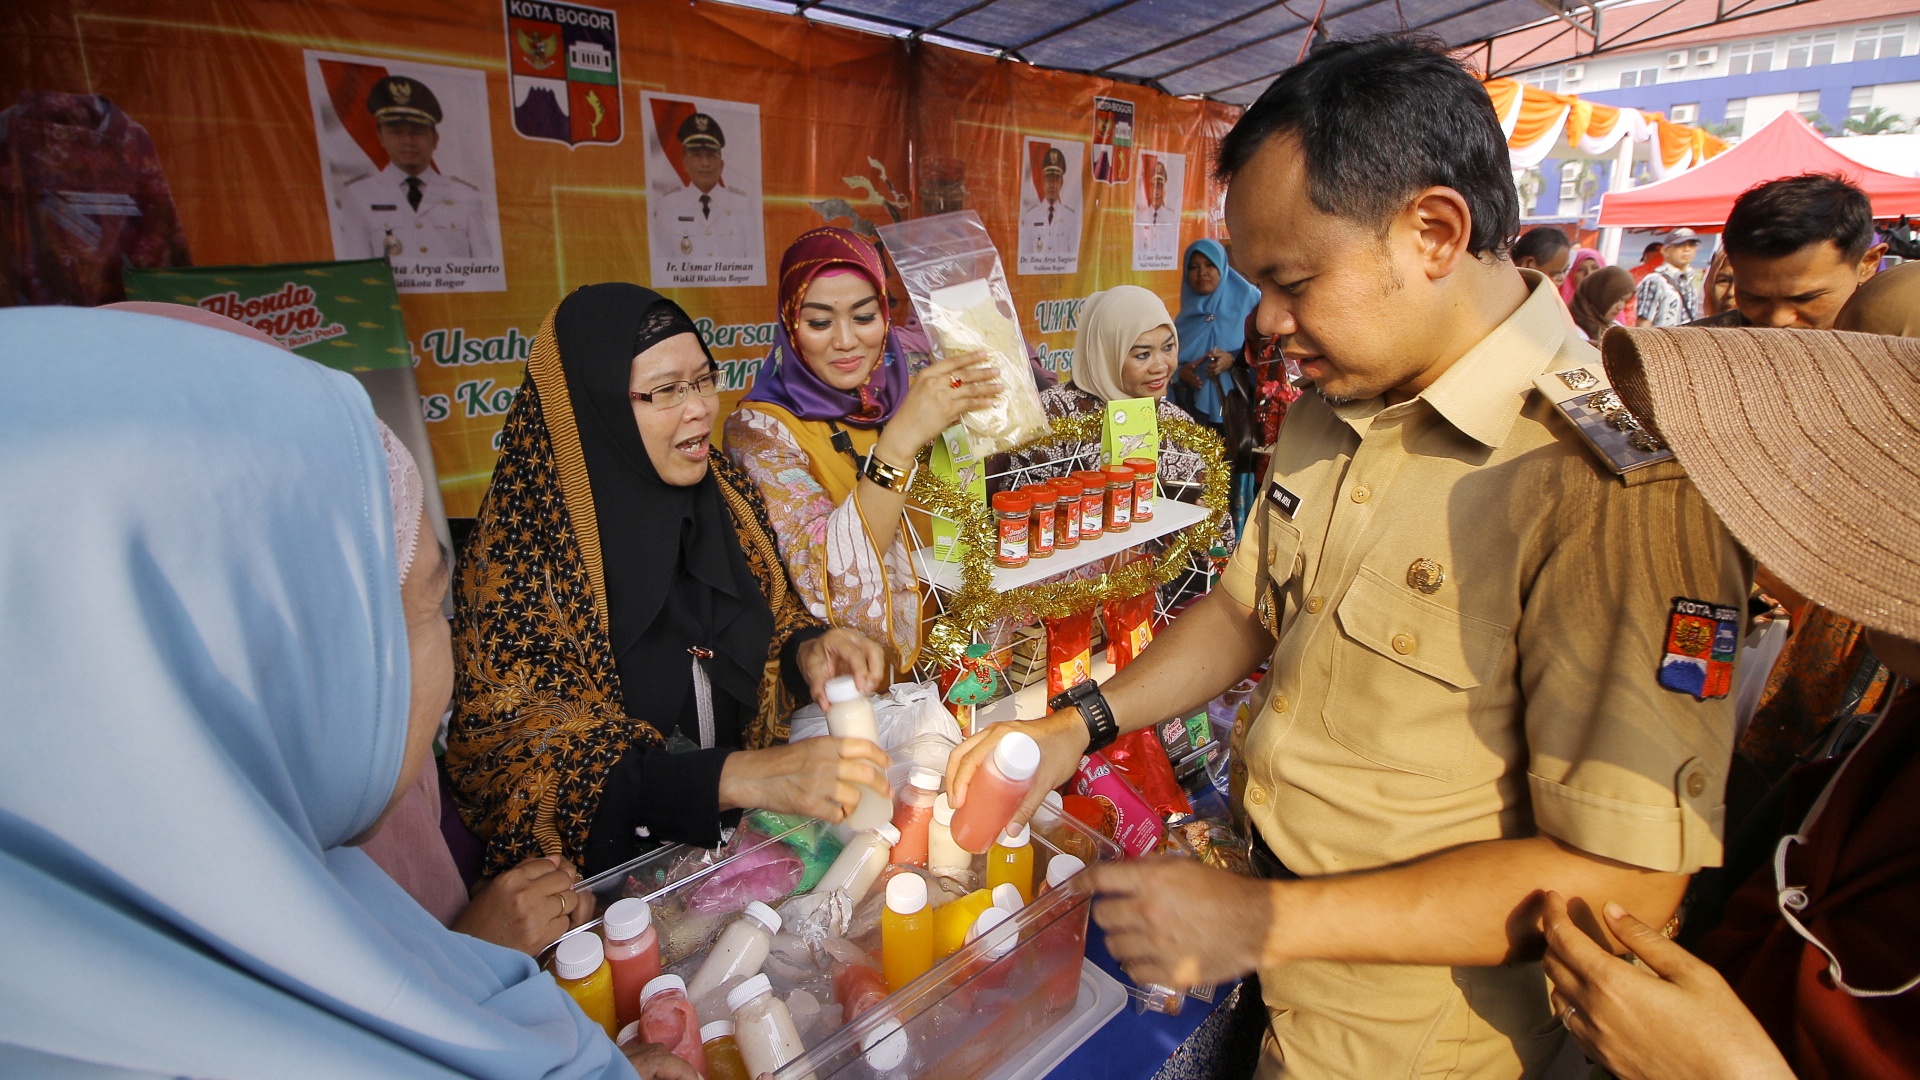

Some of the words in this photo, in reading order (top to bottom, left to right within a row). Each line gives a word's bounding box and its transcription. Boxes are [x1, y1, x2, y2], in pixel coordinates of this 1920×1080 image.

[510, 1, 553, 20] KOTA
[556, 8, 611, 30] BOGOR
[411, 264, 442, 276] Arya
[445, 263, 500, 276] Sugiarto
[681, 262, 712, 272] Usmar
[714, 262, 754, 272] Hariman
[396, 279, 432, 288] alikota
[435, 279, 465, 288] Bogor
[673, 275, 696, 283] Wakil
[697, 274, 727, 283] Walikota
[728, 274, 750, 283] Bogor
[247, 307, 321, 336] ova
[1035, 300, 1086, 331] UMK
[288, 334, 313, 347] Ikan
[315, 324, 344, 340] Peda
[424, 329, 536, 365] Usah
[1677, 600, 1713, 618] KOTA
[1085, 763, 1111, 783] Las
